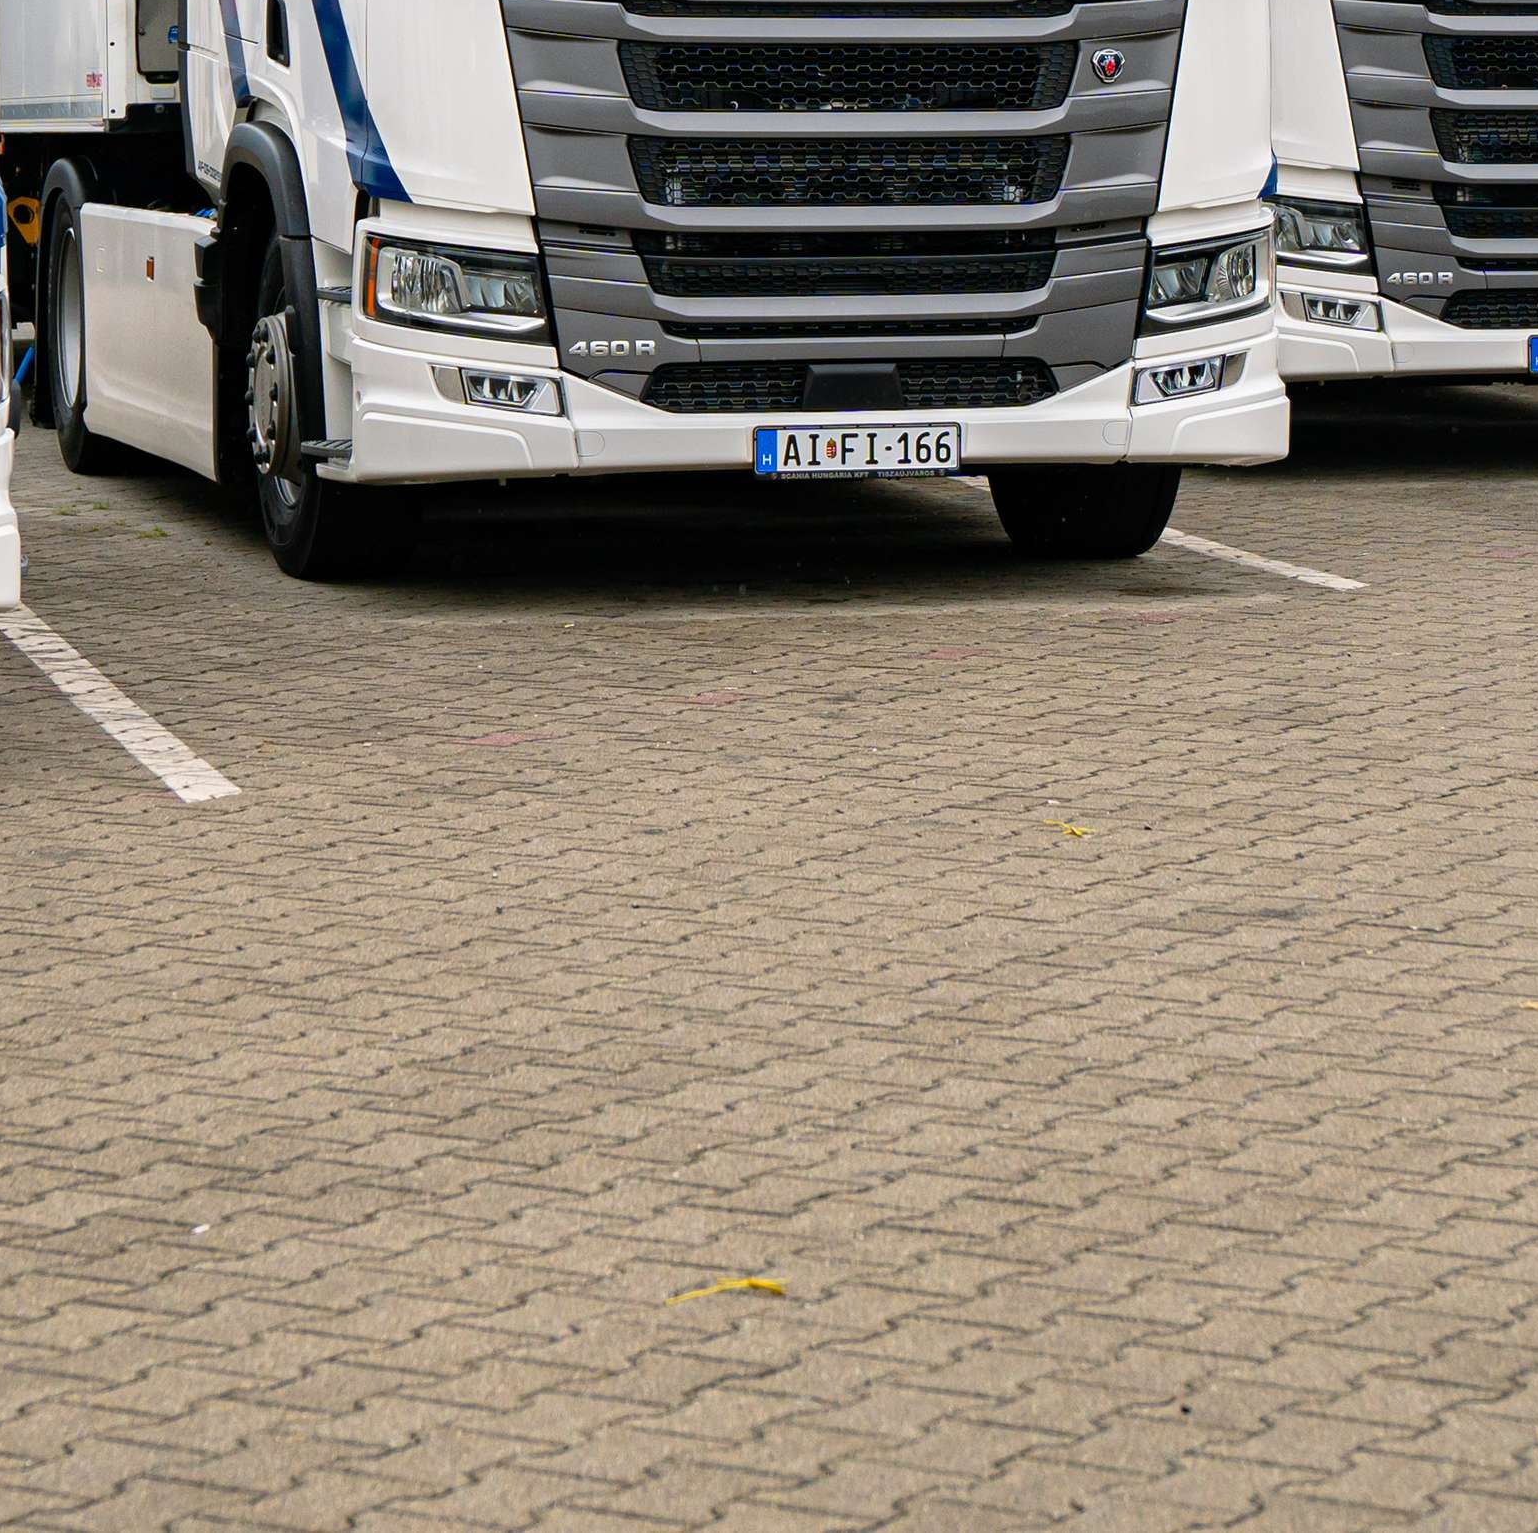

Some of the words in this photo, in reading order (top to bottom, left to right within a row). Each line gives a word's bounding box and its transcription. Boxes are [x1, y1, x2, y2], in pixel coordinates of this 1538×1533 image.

[1387, 271, 1434, 285] 460
[1437, 271, 1454, 285] R
[568, 340, 630, 357] 460
[635, 339, 656, 356] R
[783, 433, 821, 466] AI
[841, 432, 951, 465] FI-166
[762, 454, 772, 465] H
